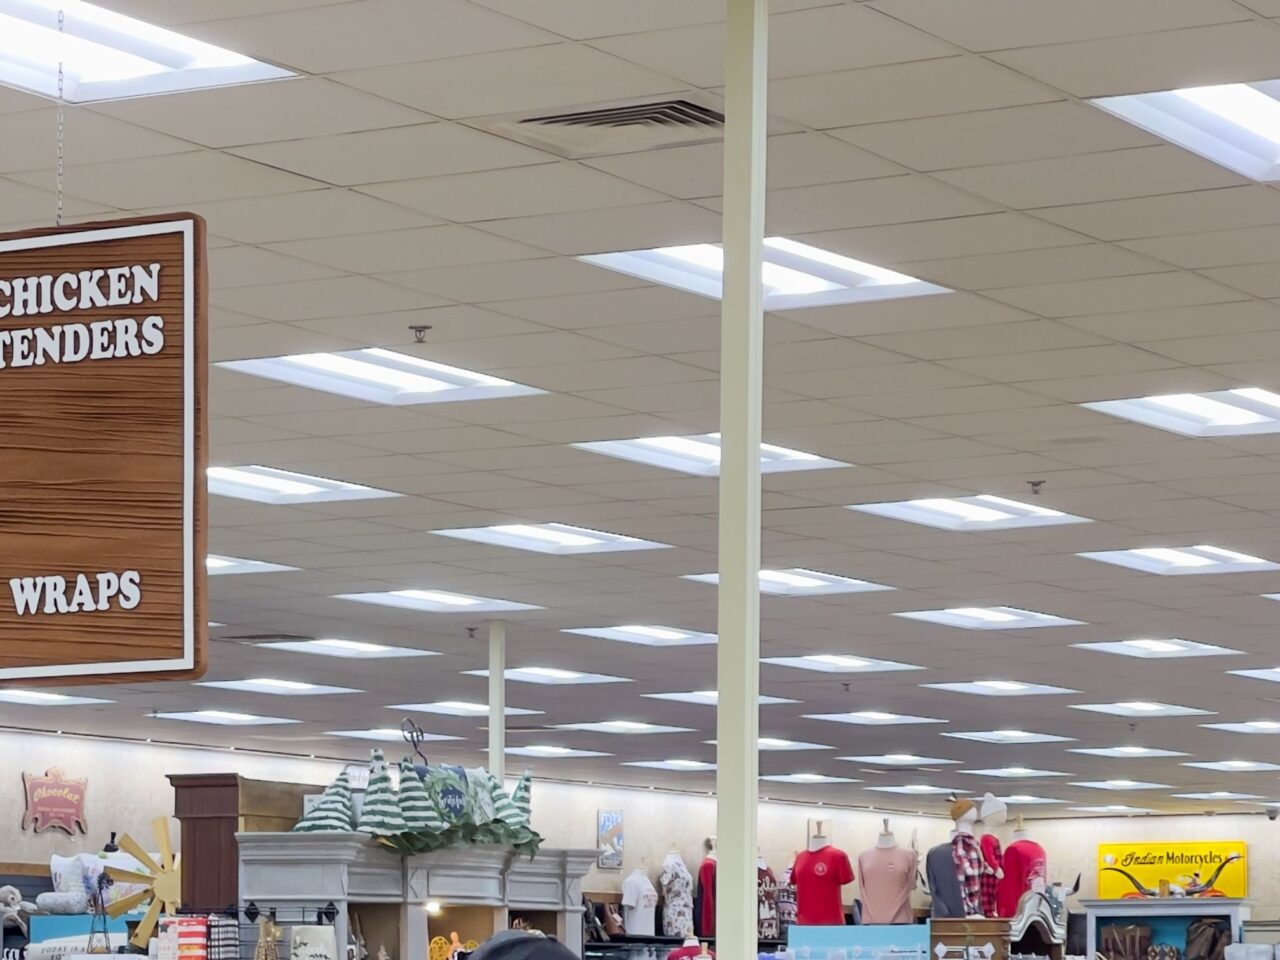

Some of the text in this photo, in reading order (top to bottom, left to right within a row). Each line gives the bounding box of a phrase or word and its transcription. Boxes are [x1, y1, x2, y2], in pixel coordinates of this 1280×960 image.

[10, 571, 142, 616] WRAPS
[1121, 850, 1222, 867] Indian Motorcycles
